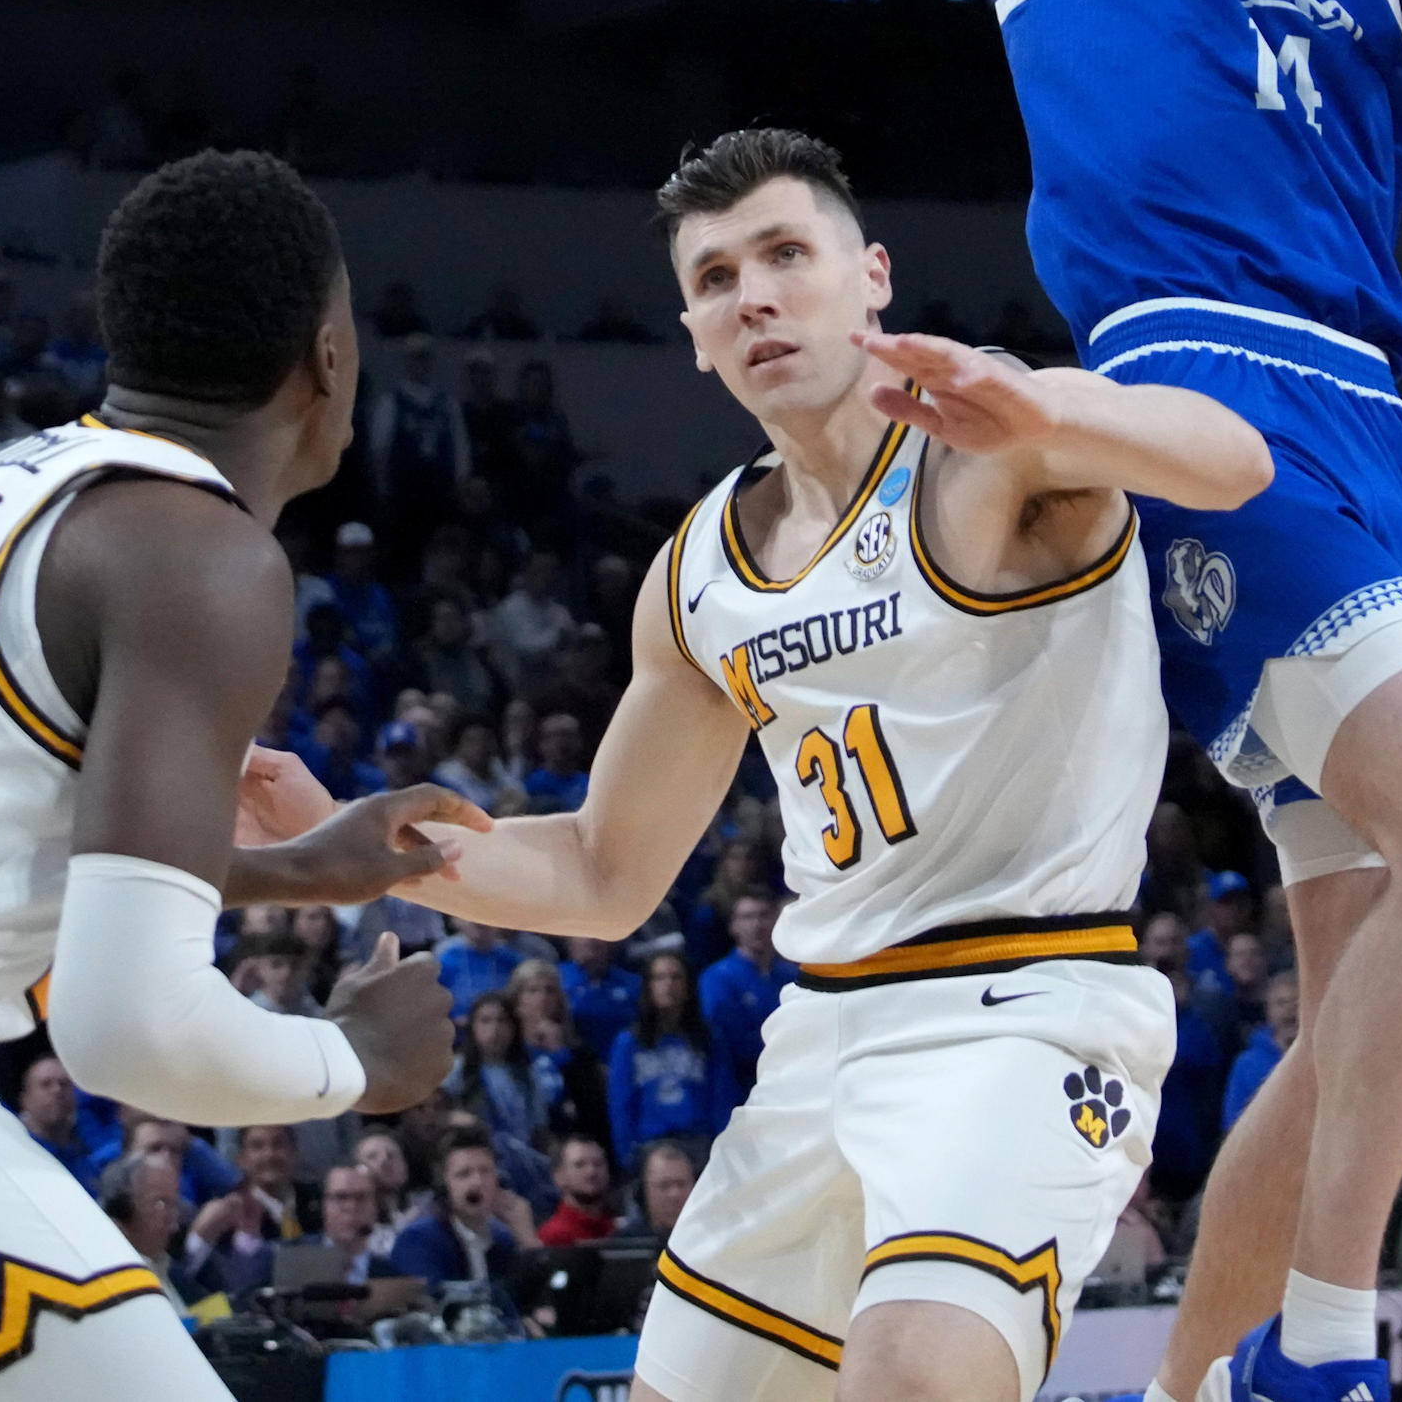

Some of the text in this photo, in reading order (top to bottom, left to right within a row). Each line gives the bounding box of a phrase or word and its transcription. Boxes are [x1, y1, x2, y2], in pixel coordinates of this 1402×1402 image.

[1250, 16, 1324, 136] 14
[858, 512, 890, 563] SEC
[720, 591, 903, 732] MISSOURI
[795, 703, 918, 871] 31
